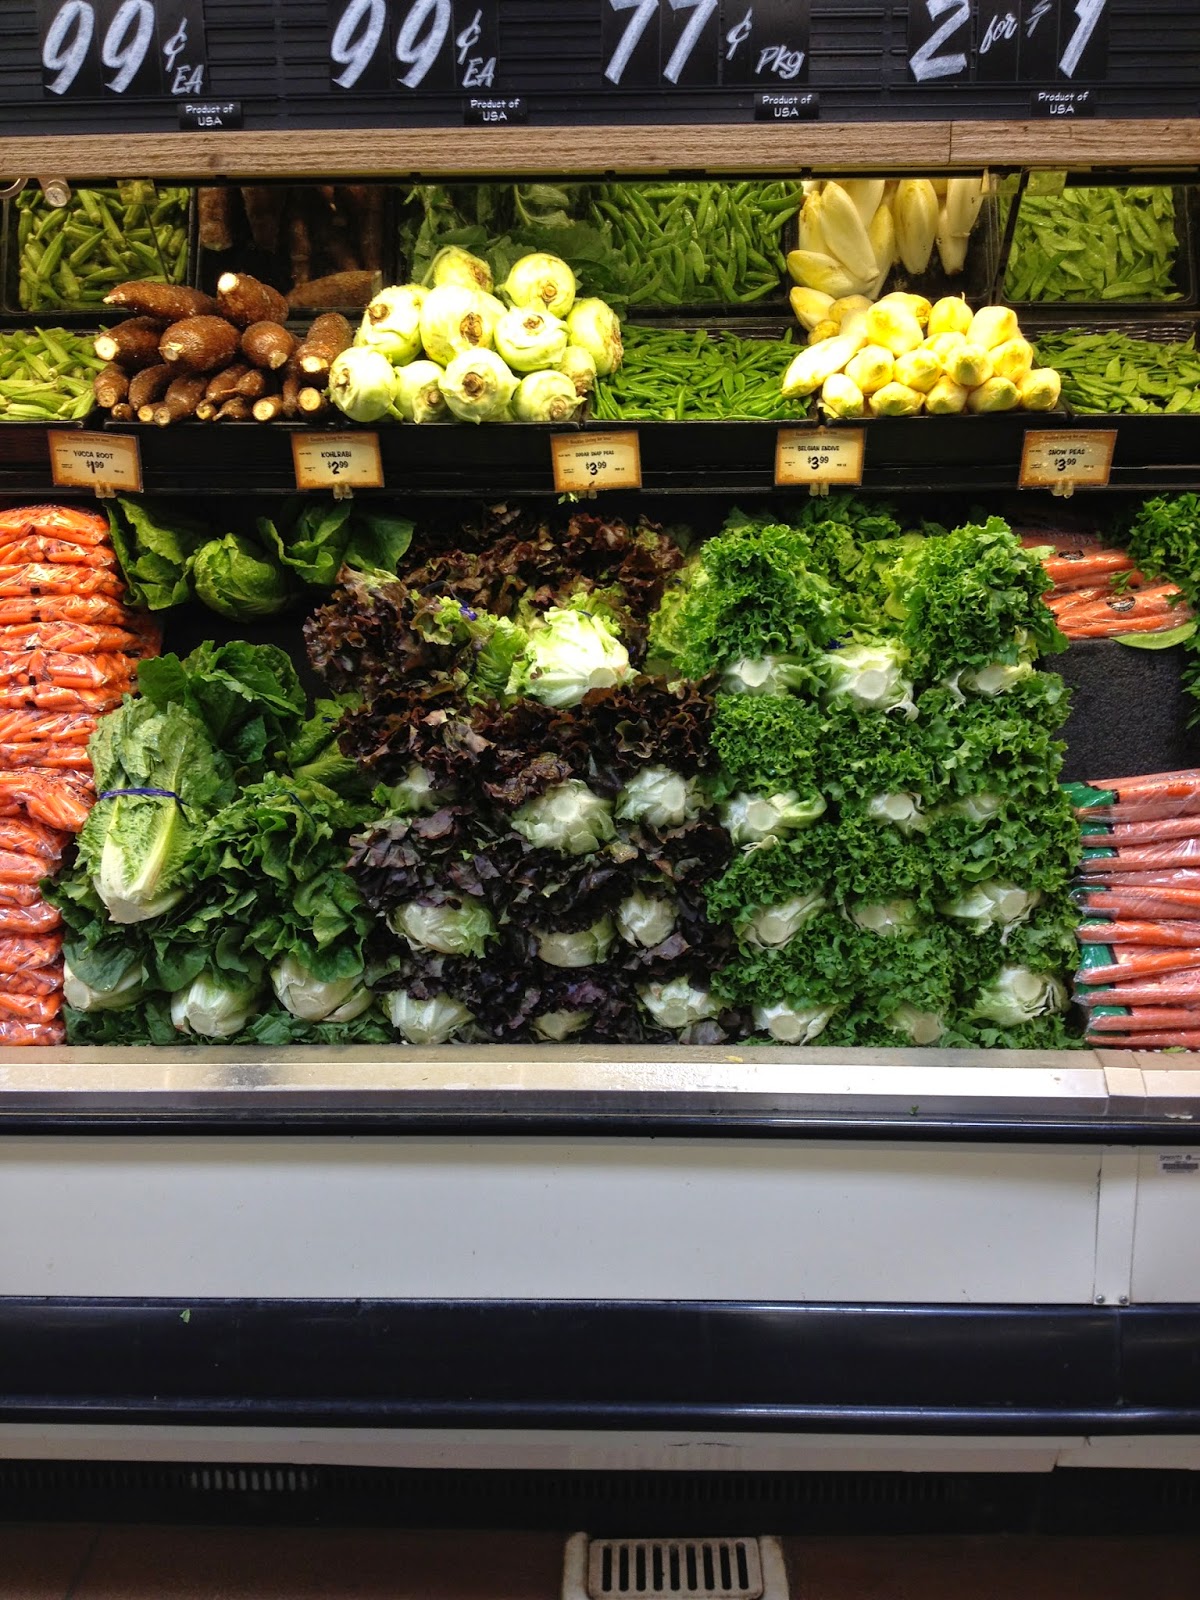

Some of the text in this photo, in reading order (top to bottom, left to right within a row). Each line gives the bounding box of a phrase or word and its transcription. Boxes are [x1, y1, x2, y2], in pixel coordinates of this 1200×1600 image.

[909, 0, 971, 82] 2
[979, 13, 1018, 54] for
[462, 57, 497, 88] EA
[171, 64, 204, 95] EA
[762, 94, 813, 105] Product of
[1038, 91, 1089, 101] Product of
[471, 98, 520, 109] Product of
[186, 104, 234, 114] Product of
[774, 107, 799, 117] USA
[1049, 105, 1075, 114] USA
[198, 117, 223, 126] USA
[482, 112, 508, 121] USA
[73, 450, 94, 458] YUCCA
[321, 451, 352, 459] KOHLRABI
